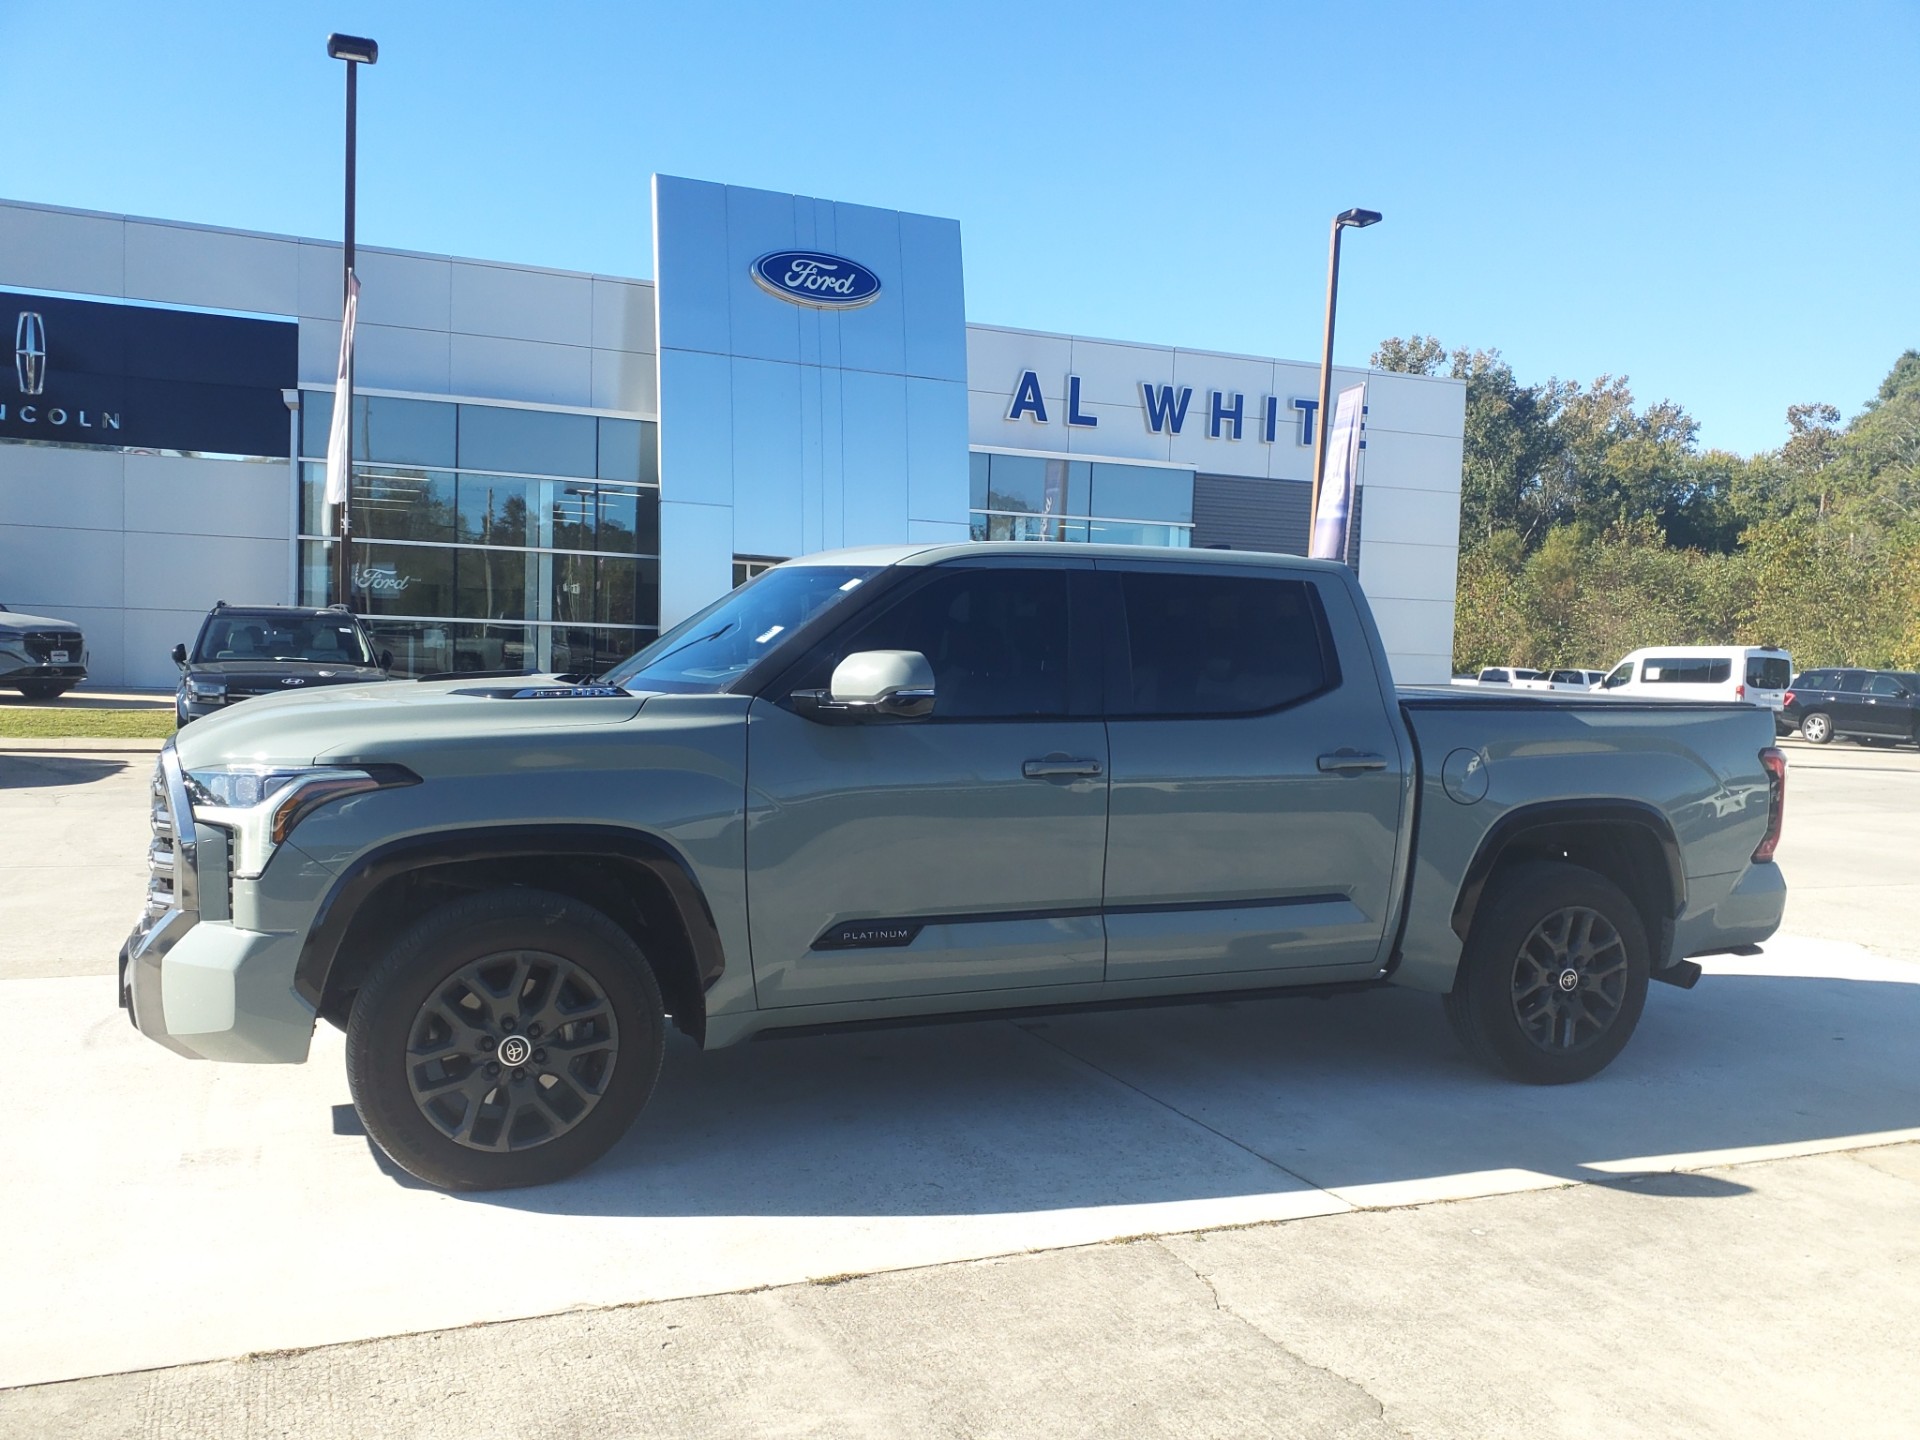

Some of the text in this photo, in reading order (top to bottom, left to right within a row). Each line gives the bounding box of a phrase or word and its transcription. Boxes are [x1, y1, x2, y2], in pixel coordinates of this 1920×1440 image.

[784, 259, 856, 294] Ford
[1006, 370, 1099, 428] AL
[358, 568, 410, 590] Ford
[843, 930, 908, 940] PLATINUM
